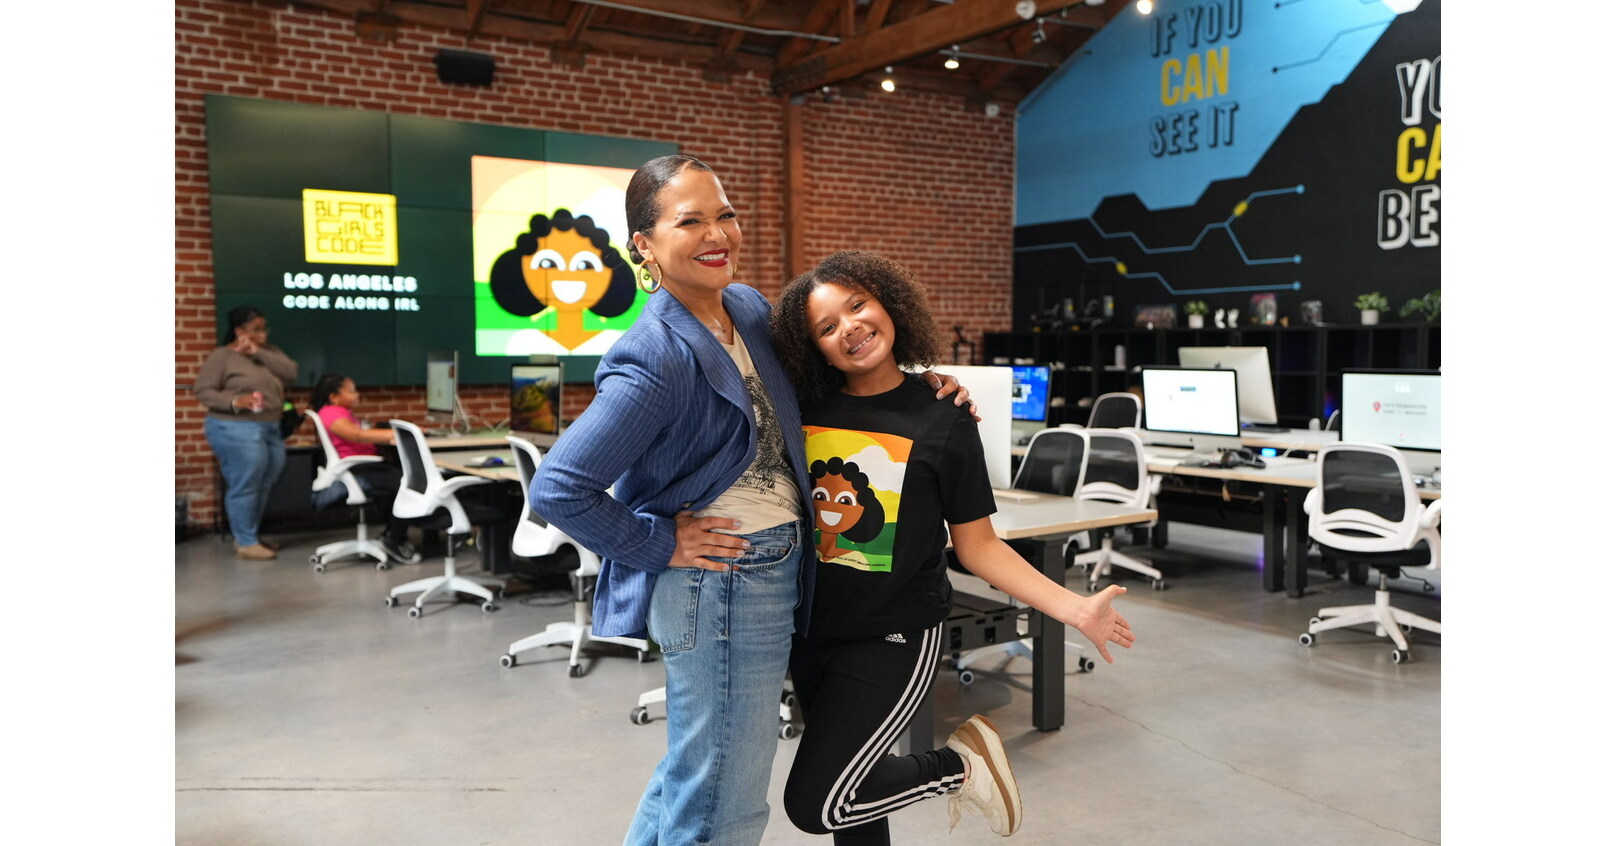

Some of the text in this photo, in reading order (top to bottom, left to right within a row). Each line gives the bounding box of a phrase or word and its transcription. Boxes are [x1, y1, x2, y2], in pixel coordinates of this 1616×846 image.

[1150, 0, 1242, 58] IF YOU
[1161, 46, 1229, 107] CAN
[1149, 101, 1239, 158] SEE IT
[315, 200, 383, 219] BLACK
[1377, 184, 1441, 250] BE
[316, 219, 383, 236] GIRLS
[316, 237, 384, 255] CODE
[283, 272, 418, 292] LOS ANGELES
[283, 295, 420, 311] CODE ALONG IRL
